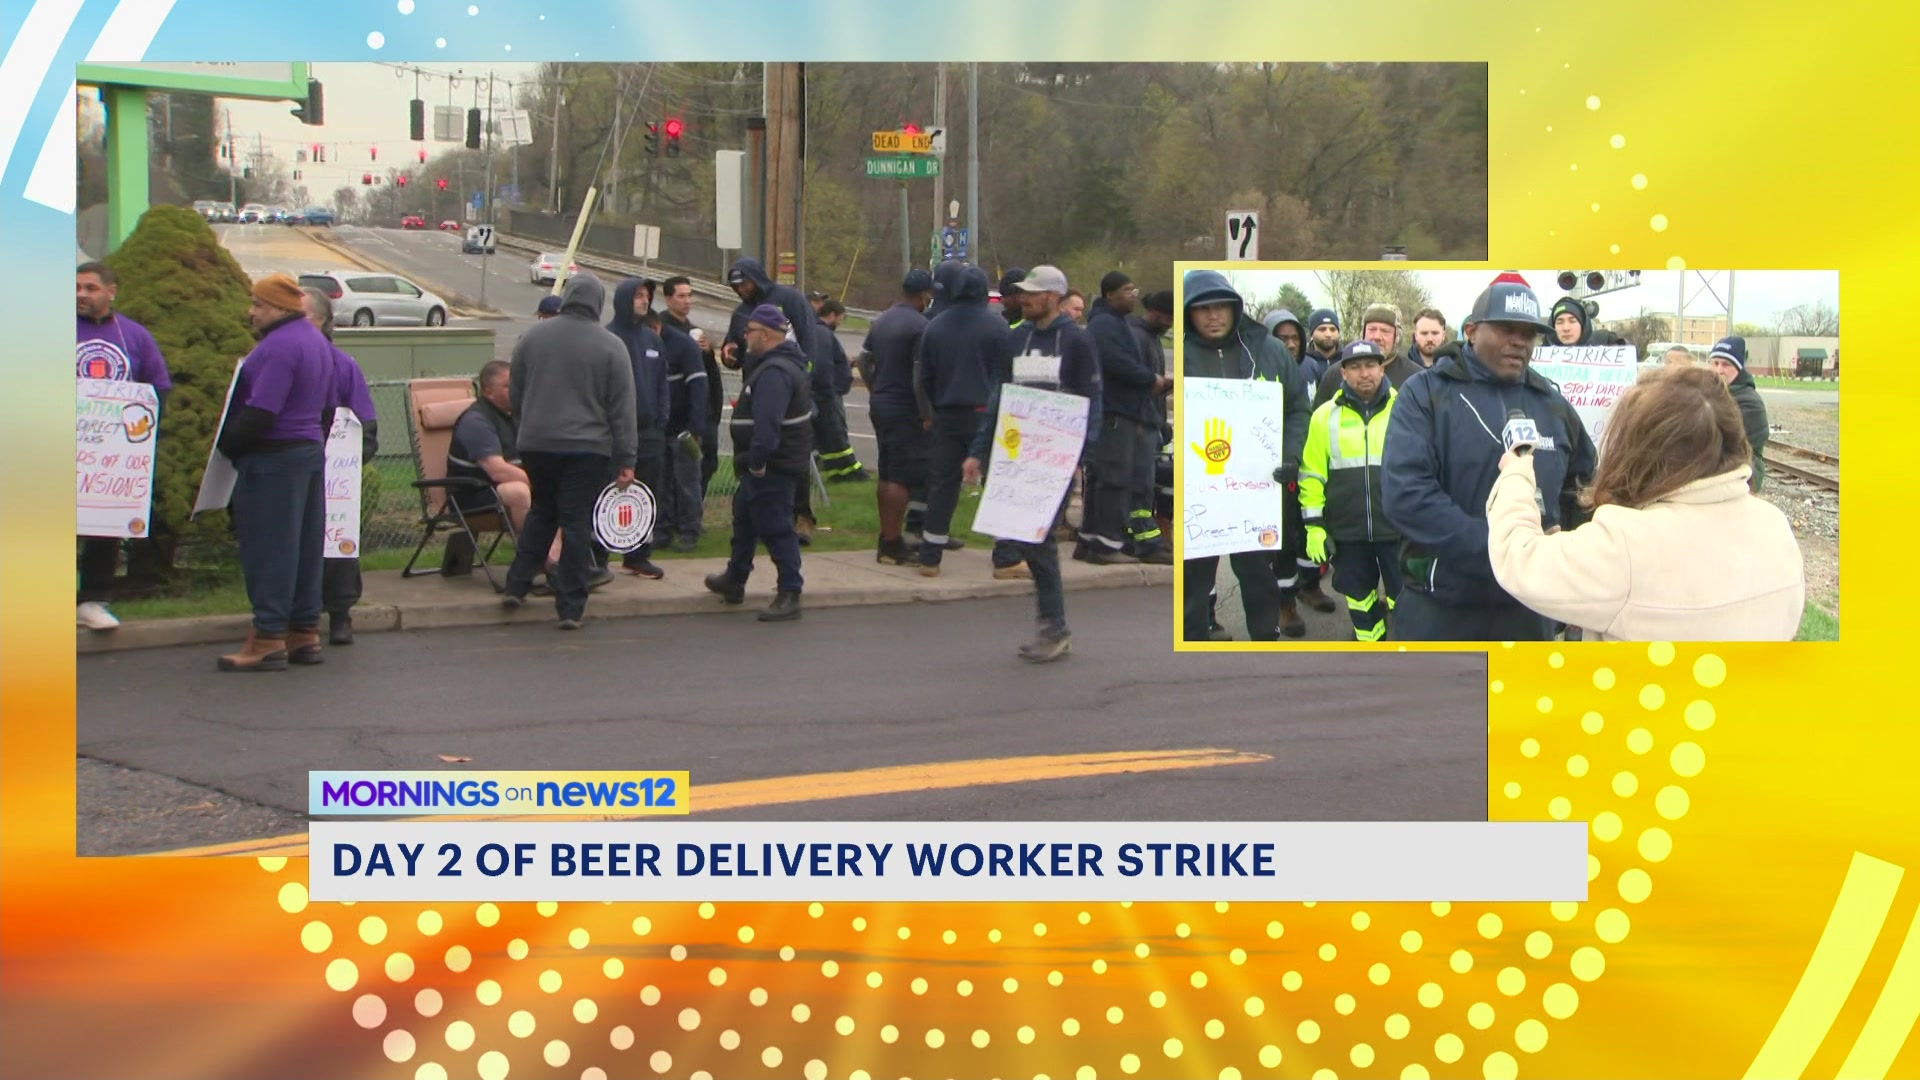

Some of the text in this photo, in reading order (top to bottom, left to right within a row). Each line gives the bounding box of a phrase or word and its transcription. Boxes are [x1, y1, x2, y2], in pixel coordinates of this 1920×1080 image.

[874, 135, 930, 149] DEAD END
[867, 159, 939, 175] DUNNIGAN DR
[1562, 381, 1594, 395] STOP
[1515, 426, 1537, 441] 12
